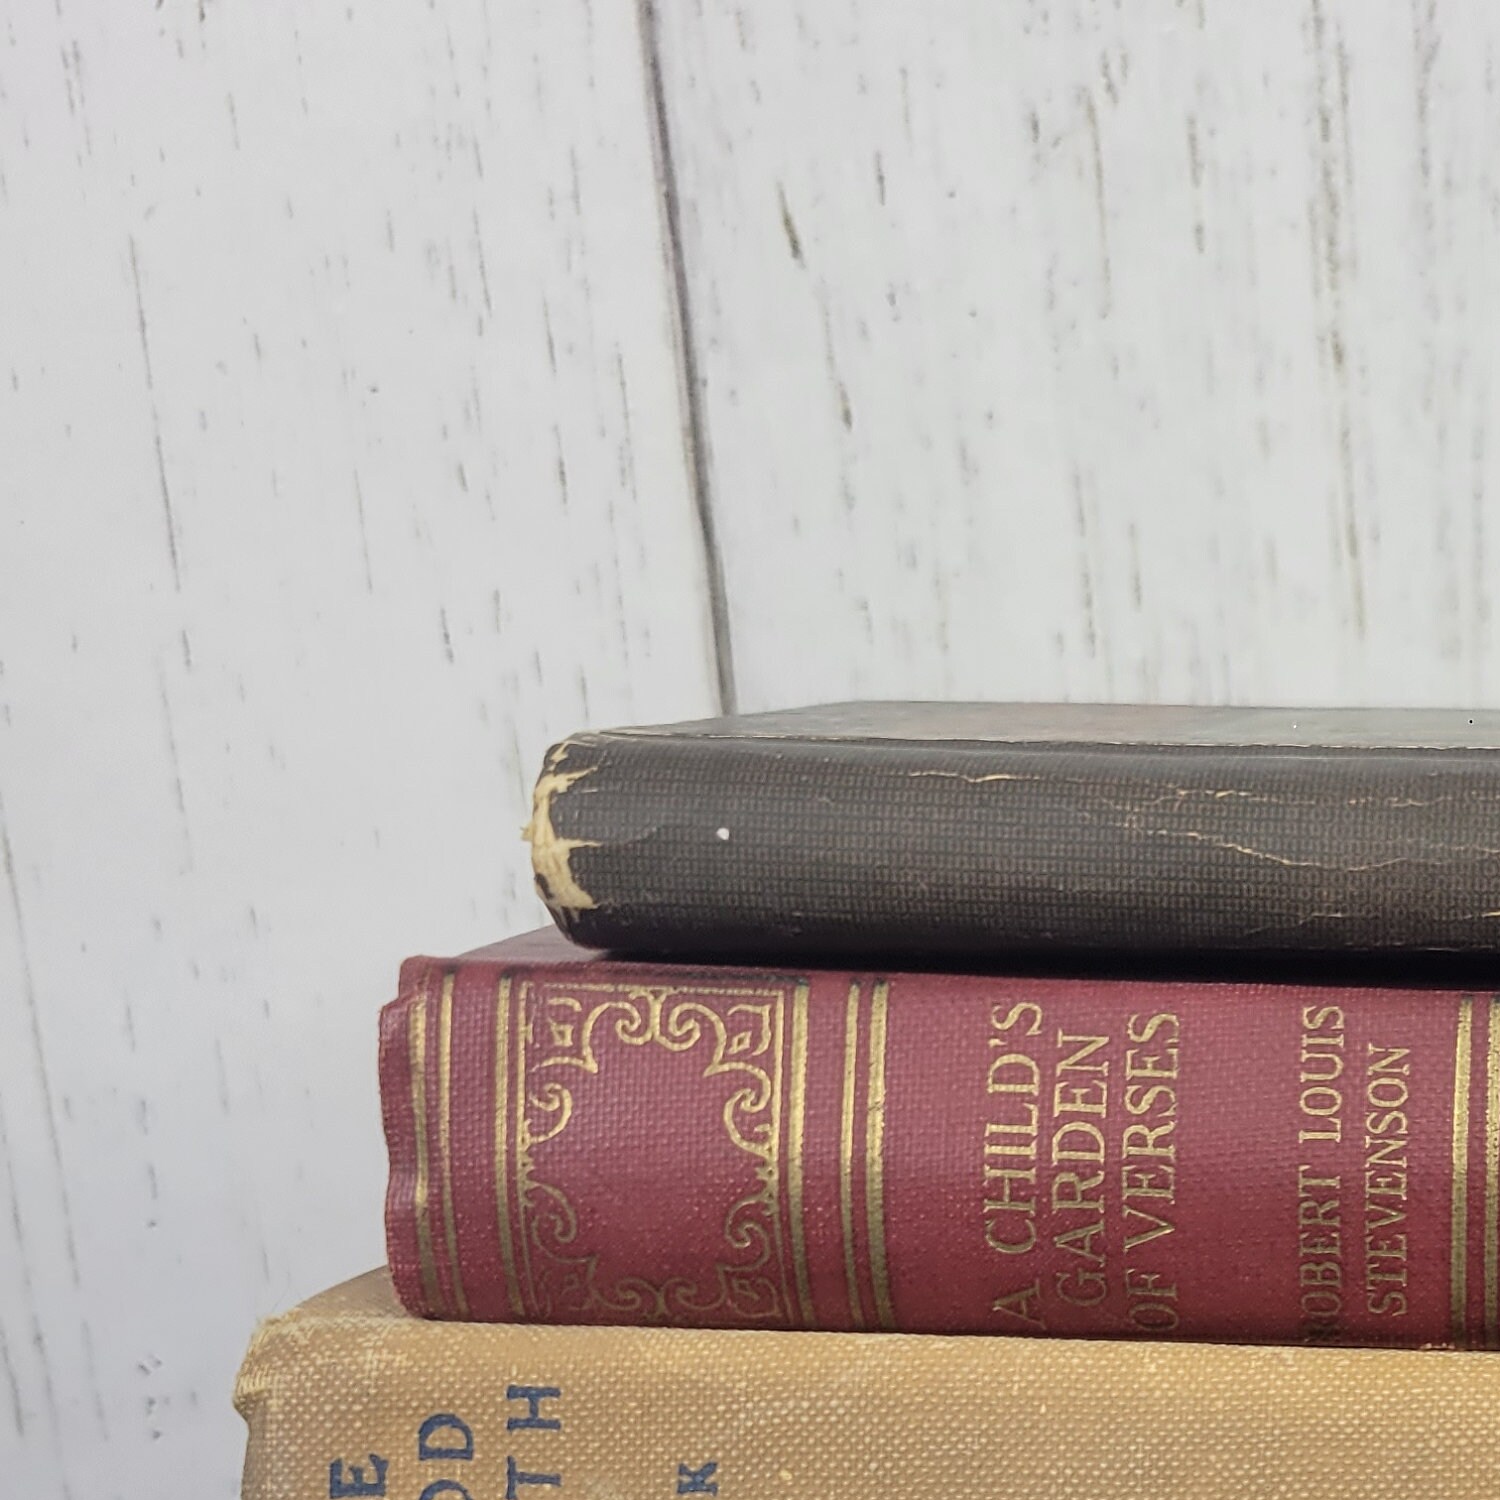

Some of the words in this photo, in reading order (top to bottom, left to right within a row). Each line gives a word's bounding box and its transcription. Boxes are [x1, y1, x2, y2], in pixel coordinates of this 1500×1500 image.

[984, 1001, 1043, 1254] CHILD'S
[1051, 1029, 1110, 1307] GARDEN
[1121, 1012, 1180, 1253] VERSES
[1298, 1005, 1346, 1144] LOUIS
[1364, 1043, 1410, 1316] STEVENSON
[993, 1280, 1047, 1331] A
[1126, 1267, 1180, 1332] OF
